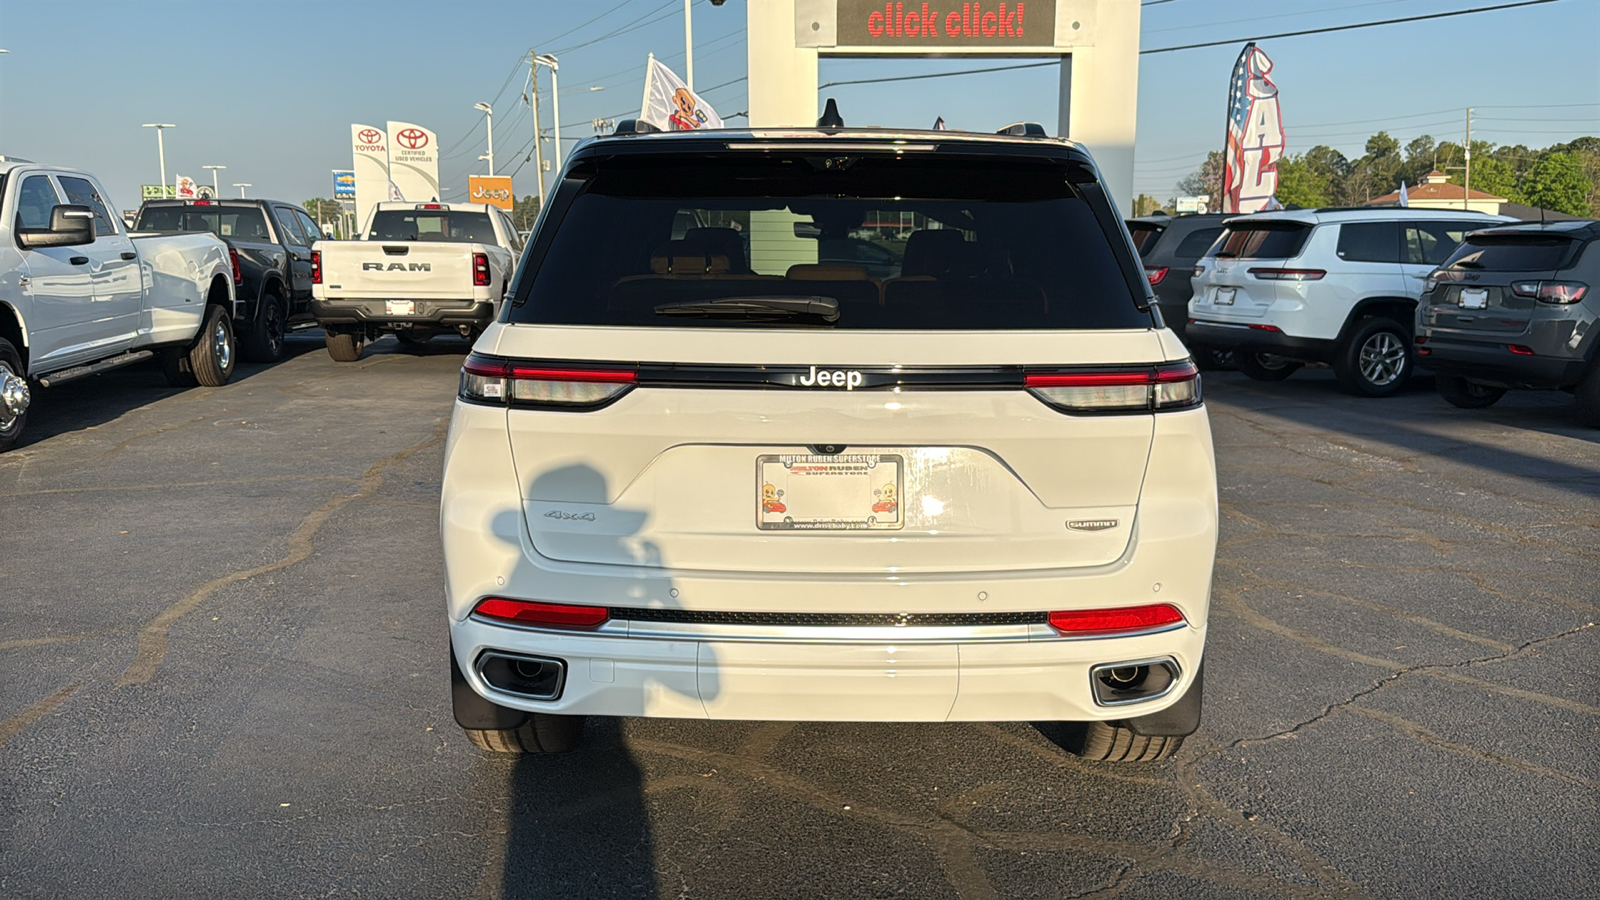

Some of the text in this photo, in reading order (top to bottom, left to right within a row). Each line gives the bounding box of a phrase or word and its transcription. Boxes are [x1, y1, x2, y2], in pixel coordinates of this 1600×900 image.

[867, 2, 1025, 38] click click!
[1236, 46, 1285, 214] SAL
[354, 144, 386, 152] TOYOTA
[472, 185, 510, 201] Jeep
[362, 262, 432, 273] RAM
[800, 365, 862, 391] Jeep
[807, 455, 832, 463] RUBEN
[833, 455, 881, 463] SUPERSTORE
[543, 510, 597, 522] 4x4
